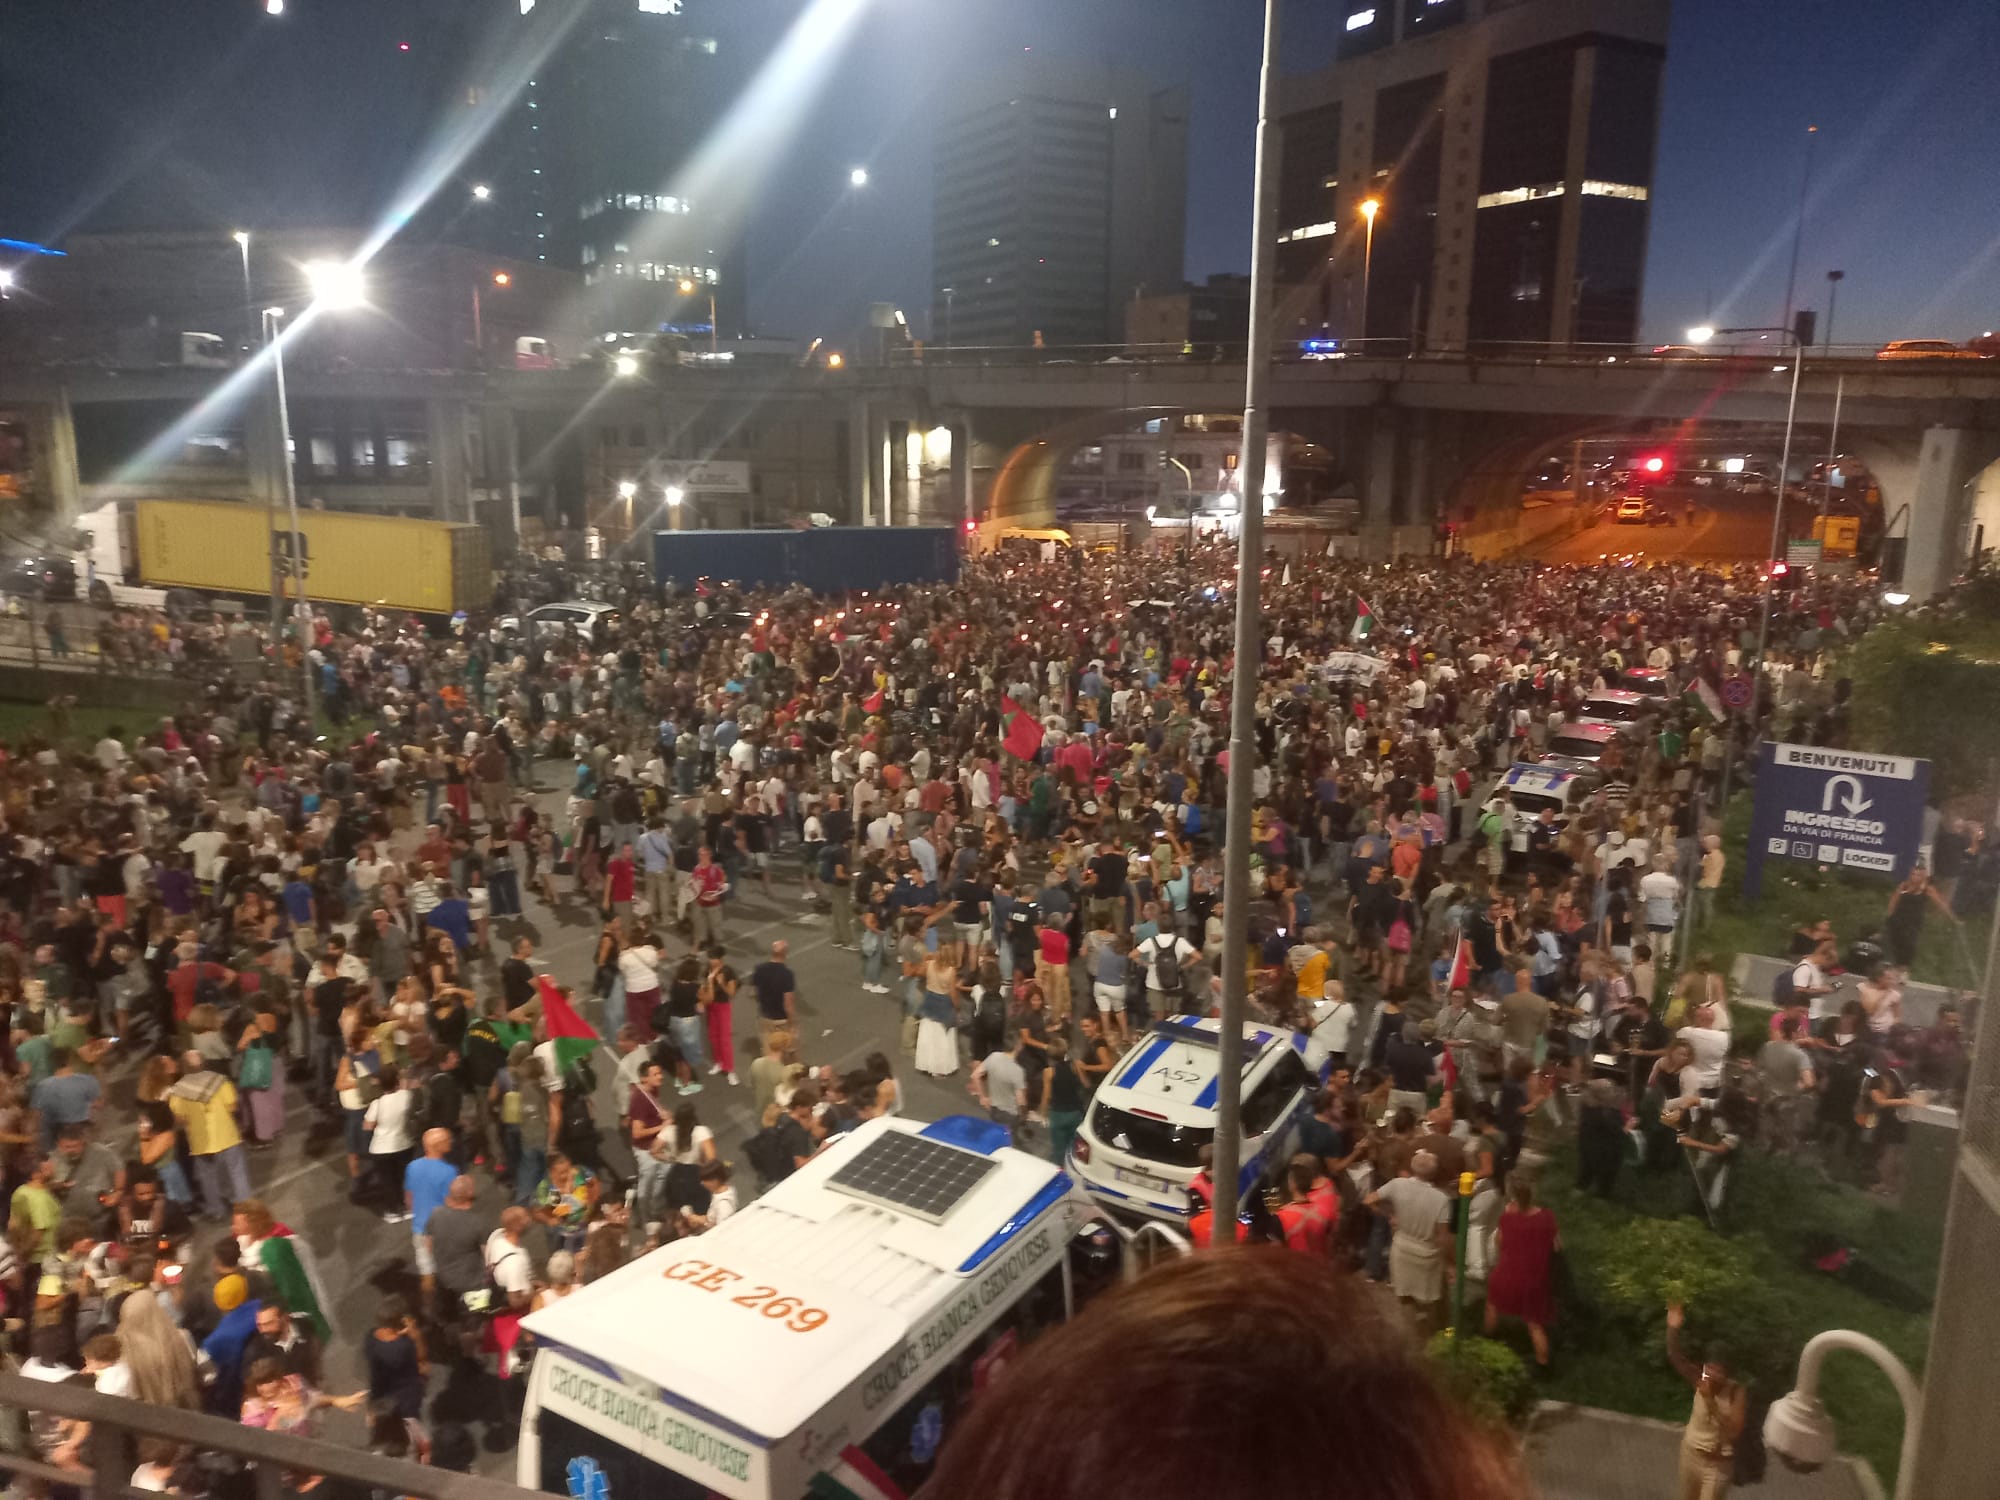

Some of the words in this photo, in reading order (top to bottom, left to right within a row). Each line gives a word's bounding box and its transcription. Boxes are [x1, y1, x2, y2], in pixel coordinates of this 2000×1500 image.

[1788, 750, 1897, 775] BENVENUTI
[1783, 824, 1799, 833] DA
[1801, 826, 1818, 837] VIA
[1820, 829, 1832, 839] DI
[1833, 831, 1883, 846] FRANCIA
[1784, 809, 1886, 836] INGRESSO
[1844, 852, 1891, 867] LOCKER
[1151, 1066, 1201, 1085] A52
[662, 1259, 744, 1293] GE
[730, 1285, 830, 1334] 269
[862, 1342, 921, 1411] CROCE
[919, 1290, 979, 1361] BIANCA
[978, 1228, 1051, 1307] GENOVESE
[550, 1364, 600, 1411] CROCE
[599, 1386, 660, 1440] BIANCA
[661, 1415, 752, 1483] GENOVESE
